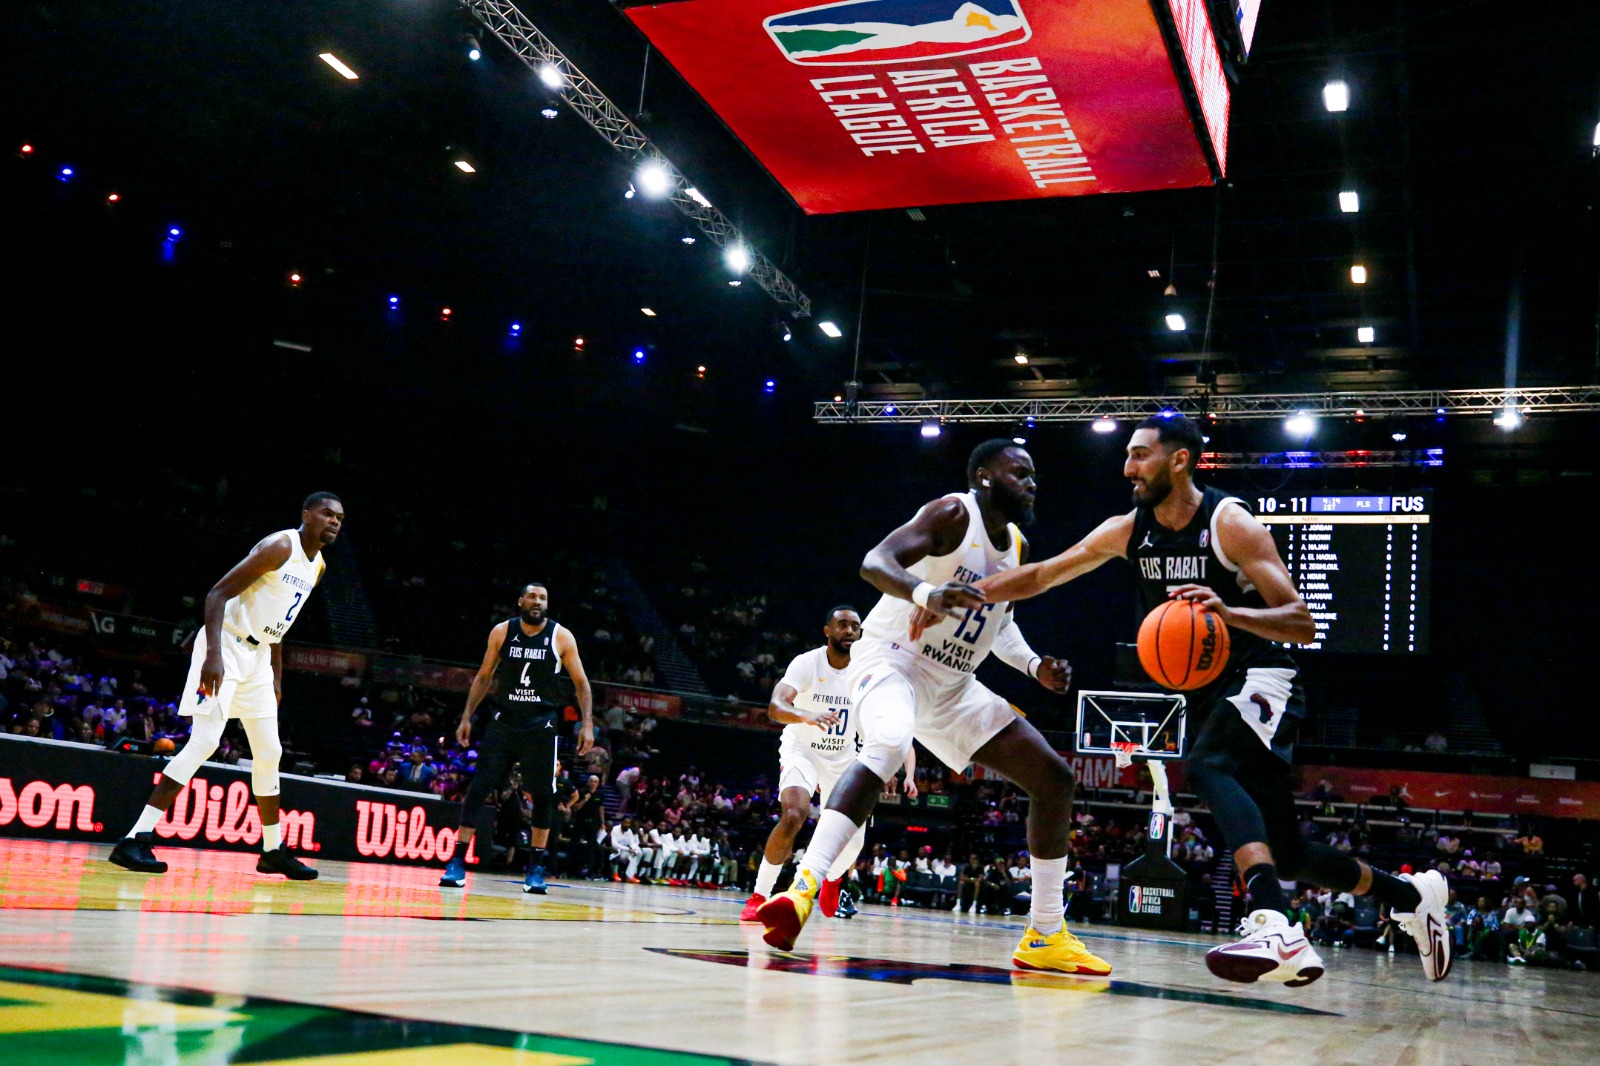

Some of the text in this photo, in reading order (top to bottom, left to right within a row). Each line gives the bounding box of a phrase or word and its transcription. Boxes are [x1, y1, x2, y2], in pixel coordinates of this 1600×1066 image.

[809, 74, 926, 157] LEAGUE
[886, 68, 996, 149] AFRICA
[967, 56, 1097, 189] BASKETBALL
[1257, 497, 1277, 513] 10
[1290, 497, 1307, 513] 11
[1356, 500, 1371, 508] FLS
[1391, 496, 1424, 512] FUS
[1139, 556, 1208, 580] FUS RABAT
[285, 592, 302, 622] 2
[509, 646, 547, 660] FUS RABAT
[942, 639, 975, 661] VISIT
[520, 661, 531, 687] 4
[508, 693, 541, 702] RWANDA
[515, 688, 535, 696] VISIT
[813, 693, 833, 705] PETRO
[811, 742, 845, 751] RWAN
[1142, 887, 1175, 897] BASKETBALL
[1142, 896, 1161, 905] AFRICA
[1141, 905, 1162, 914] LEAGUE
